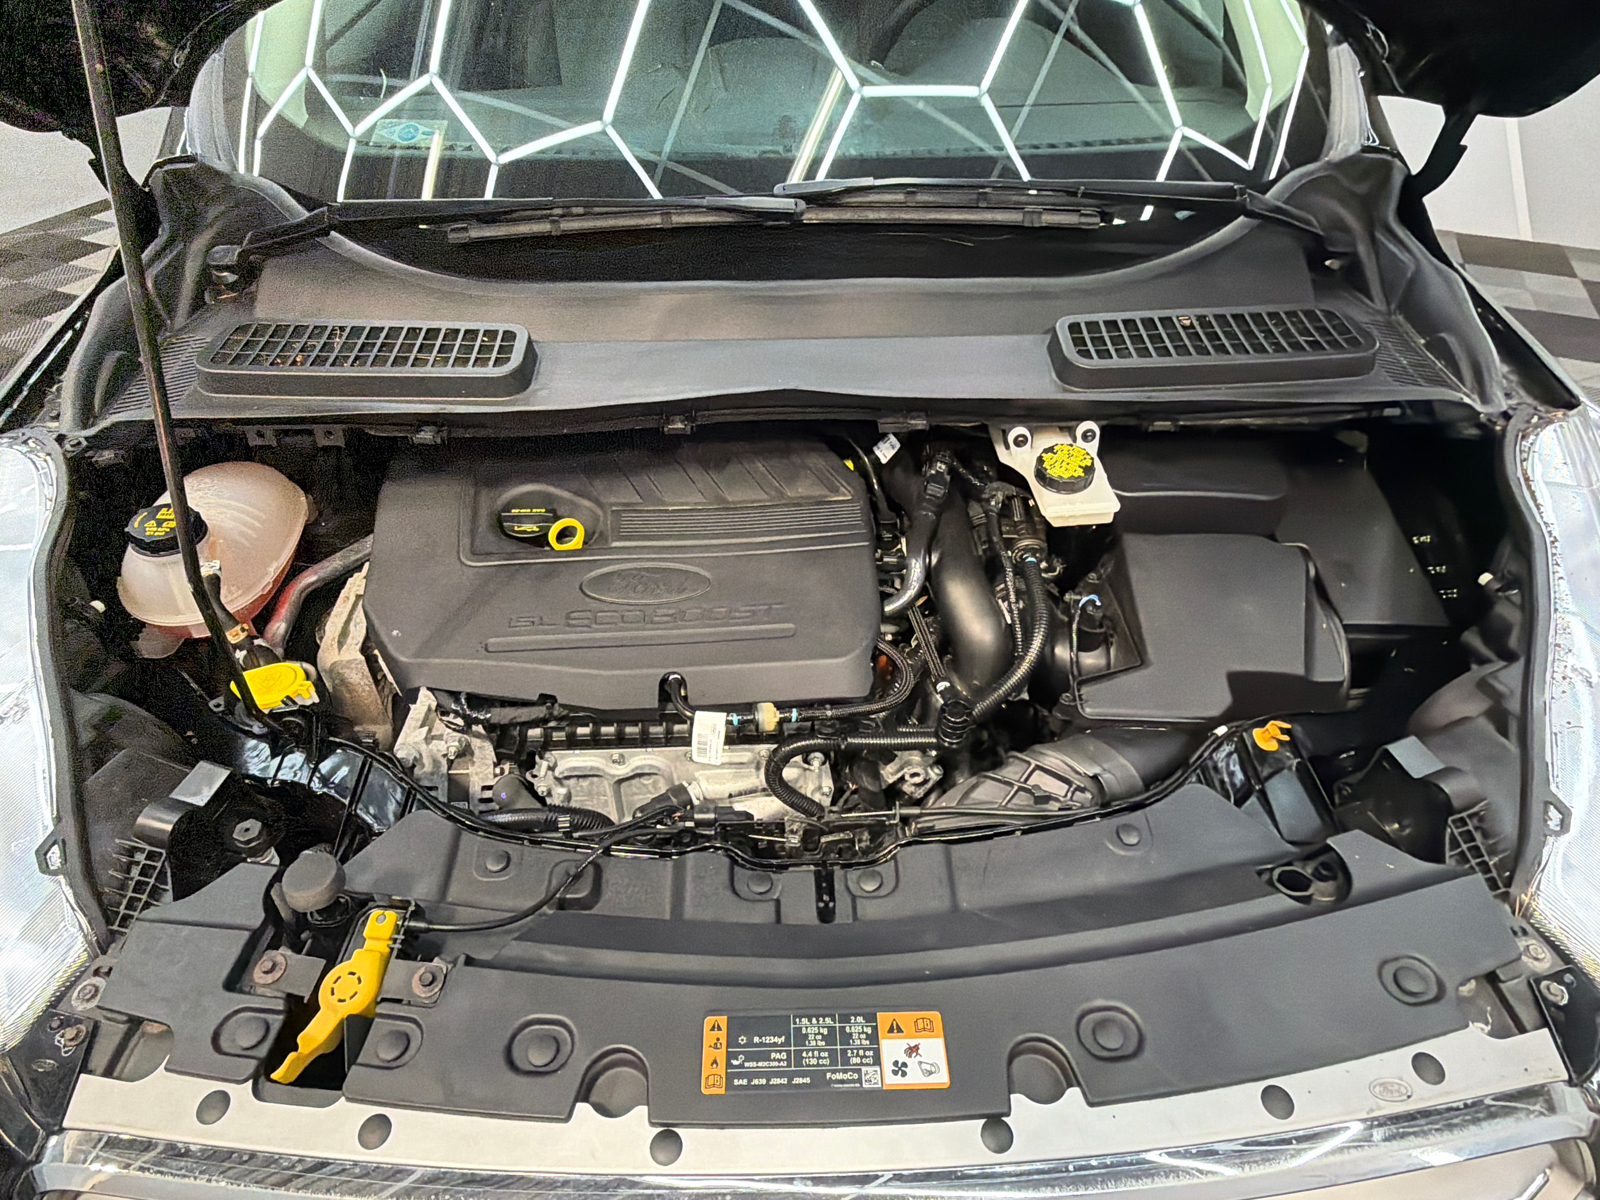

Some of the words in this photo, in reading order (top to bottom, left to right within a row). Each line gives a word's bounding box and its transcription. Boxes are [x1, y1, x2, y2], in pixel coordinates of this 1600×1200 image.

[795, 1017, 810, 1025] 1.5L
[811, 1017, 818, 1025] &
[819, 1017, 834, 1025] 2.5L
[801, 1026, 819, 1034] 0.625
[820, 1026, 828, 1035] kg
[845, 1025, 863, 1033] 0.625
[863, 1025, 872, 1034] kg
[753, 1035, 785, 1044] R-1234yf
[770, 1052, 787, 1060] PAG
[847, 1049, 858, 1057] 2.7
[802, 1058, 817, 1066] (130
[818, 1058, 830, 1066] cc)
[849, 1057, 861, 1065] (80
[862, 1057, 873, 1065] cc)
[826, 1072, 859, 1080] FoMoCo
[733, 1078, 748, 1086] SAE
